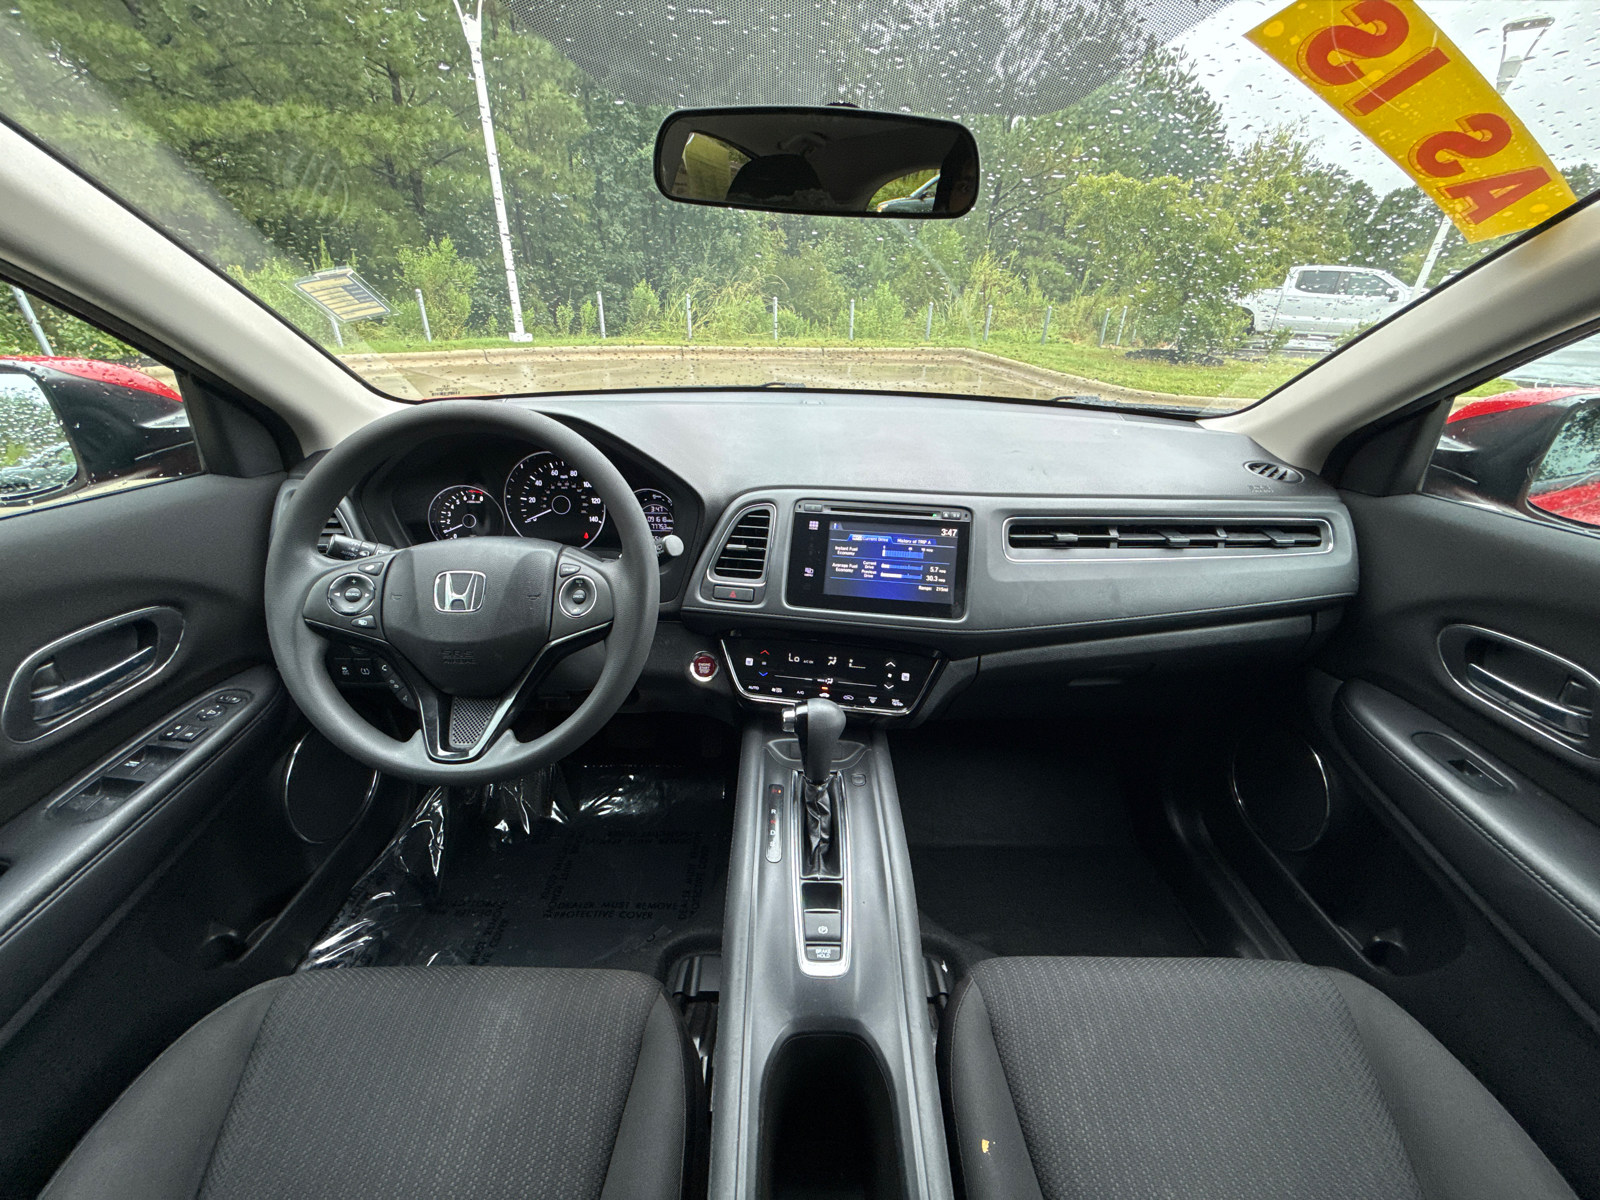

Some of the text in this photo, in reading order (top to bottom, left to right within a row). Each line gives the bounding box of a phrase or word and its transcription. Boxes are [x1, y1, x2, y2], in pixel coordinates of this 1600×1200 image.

[941, 528, 958, 537] 3:47
[926, 574, 938, 582] 30.3
[788, 652, 800, 663] Lo
[557, 901, 678, 910] DEALER MUST REMOVE
[553, 910, 654, 920] PROTECTIVE COVER
